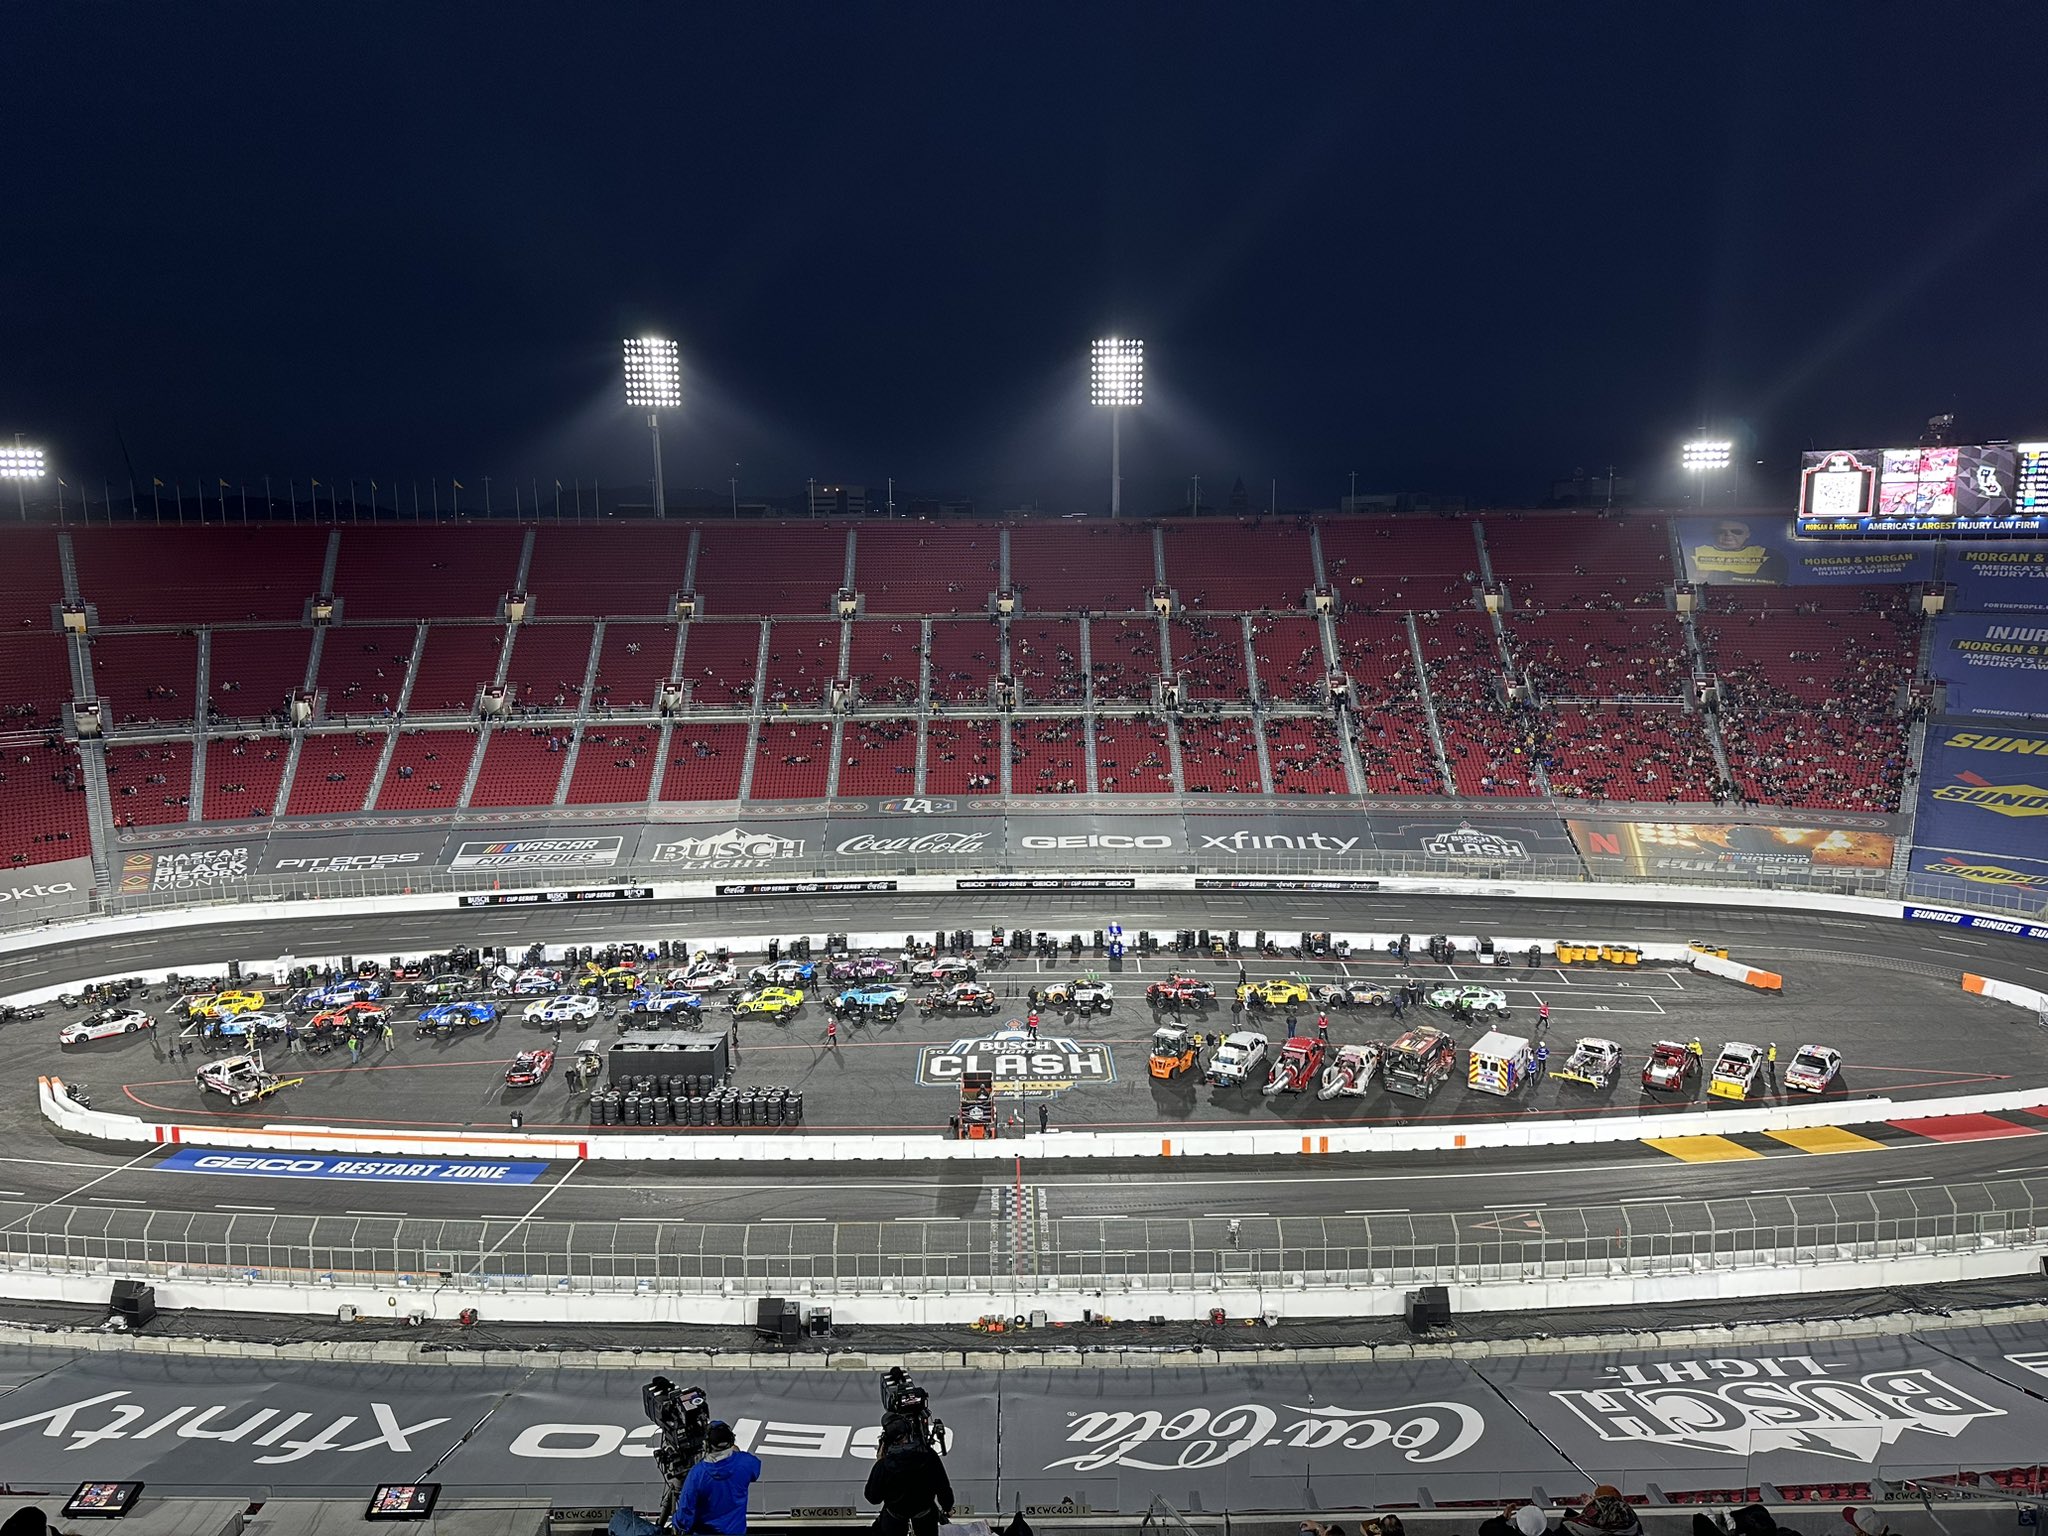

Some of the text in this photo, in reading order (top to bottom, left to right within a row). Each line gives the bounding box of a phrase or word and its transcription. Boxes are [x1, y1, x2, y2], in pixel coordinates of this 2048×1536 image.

[1868, 520, 2039, 530] AMERICA'S LARGEST INJURY LAW FIRM
[1804, 557, 1851, 565] MORGAN
[1865, 553, 1913, 563] MORGAN
[1966, 552, 2044, 562] MORGAN &
[1958, 640, 2039, 655] MORGAN &
[1962, 653, 2034, 664] AMERICA'S
[1968, 659, 2019, 668] INJURY
[1938, 787, 2048, 809] SUNO
[511, 840, 599, 853] NASCAR
[836, 832, 993, 855] Coca-Cola
[1021, 835, 1171, 849] GEICO
[1201, 831, 1359, 855] xfinity
[1588, 832, 1620, 855] N
[157, 847, 248, 862] NASCAR
[650, 840, 805, 862] BUSCH
[1428, 843, 1522, 856] CLASH
[275, 853, 420, 868] PIT BOSS
[476, 852, 596, 865] CUP SERIES
[682, 859, 772, 869] LIGHT
[1741, 855, 1811, 864] NASCAR
[155, 860, 248, 876] BLACK
[309, 864, 385, 872] GRILLS
[1656, 858, 1885, 877] FULL SPEED
[1929, 863, 2048, 884] SUNOCO
[154, 868, 248, 882] HISTORY
[1911, 909, 1962, 924] SUNOCO
[1971, 917, 2021, 933] SUNOCO
[862, 966, 876, 975] ally
[978, 1041, 1051, 1051] BUSCH
[929, 1054, 1103, 1076] CLASH
[193, 1155, 511, 1179] GEICO RESTART ZONE
[1616, 1355, 1830, 1386] LIGHT
[1549, 1369, 2008, 1442] BUSCH
[0, 1391, 451, 1464] xfinity
[1042, 1401, 1485, 1471] Coca-Cola
[565, 1510, 602, 1520] CWC405
[802, 1508, 853, 1517] CWC405 3
[964, 1506, 970, 1515] 2
[1036, 1506, 1073, 1515] CWC405
